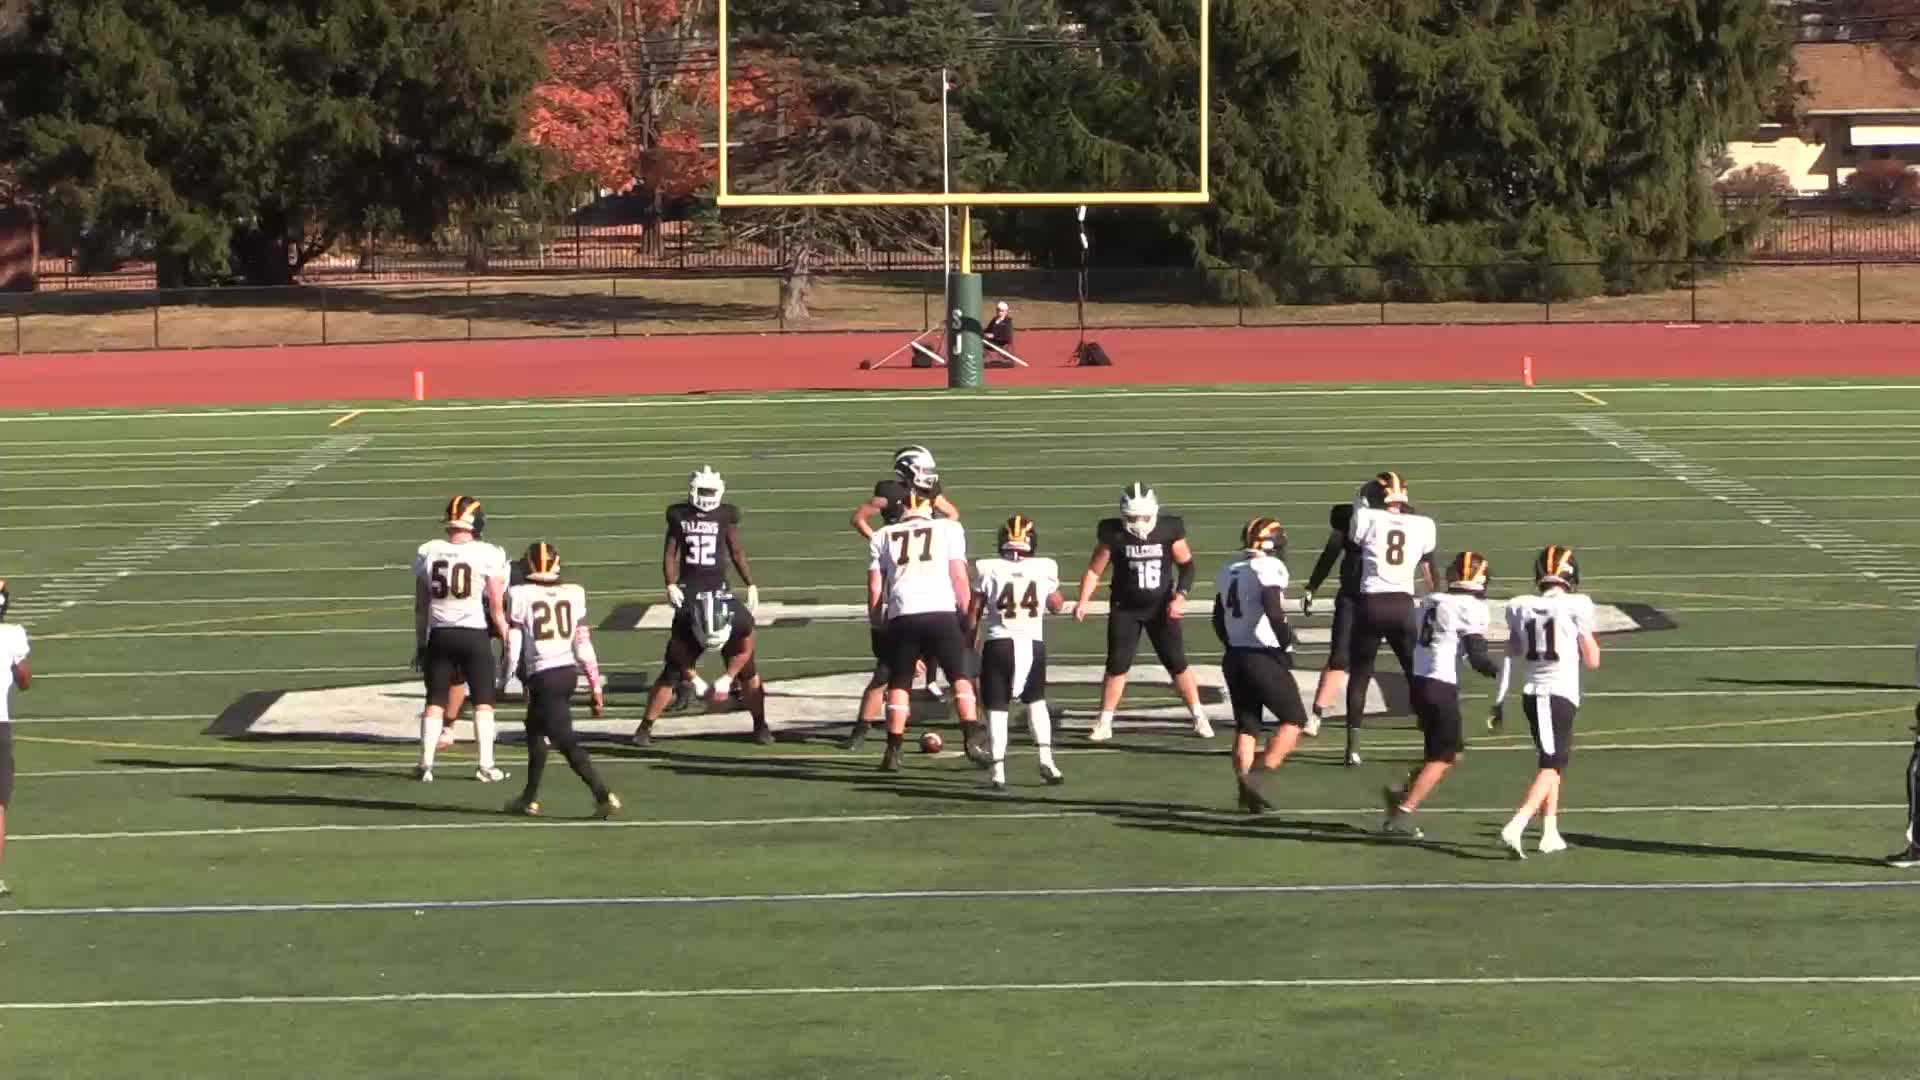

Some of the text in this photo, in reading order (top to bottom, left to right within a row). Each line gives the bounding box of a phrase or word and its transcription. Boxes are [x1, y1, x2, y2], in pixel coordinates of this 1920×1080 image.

[685, 535, 717, 565] 32
[891, 527, 933, 566] 77
[1385, 529, 1406, 566] 8
[431, 560, 473, 600] 50
[996, 580, 1039, 619] 44
[1225, 577, 1243, 619] 4
[531, 600, 573, 641] 20
[1525, 616, 1560, 661] 11
